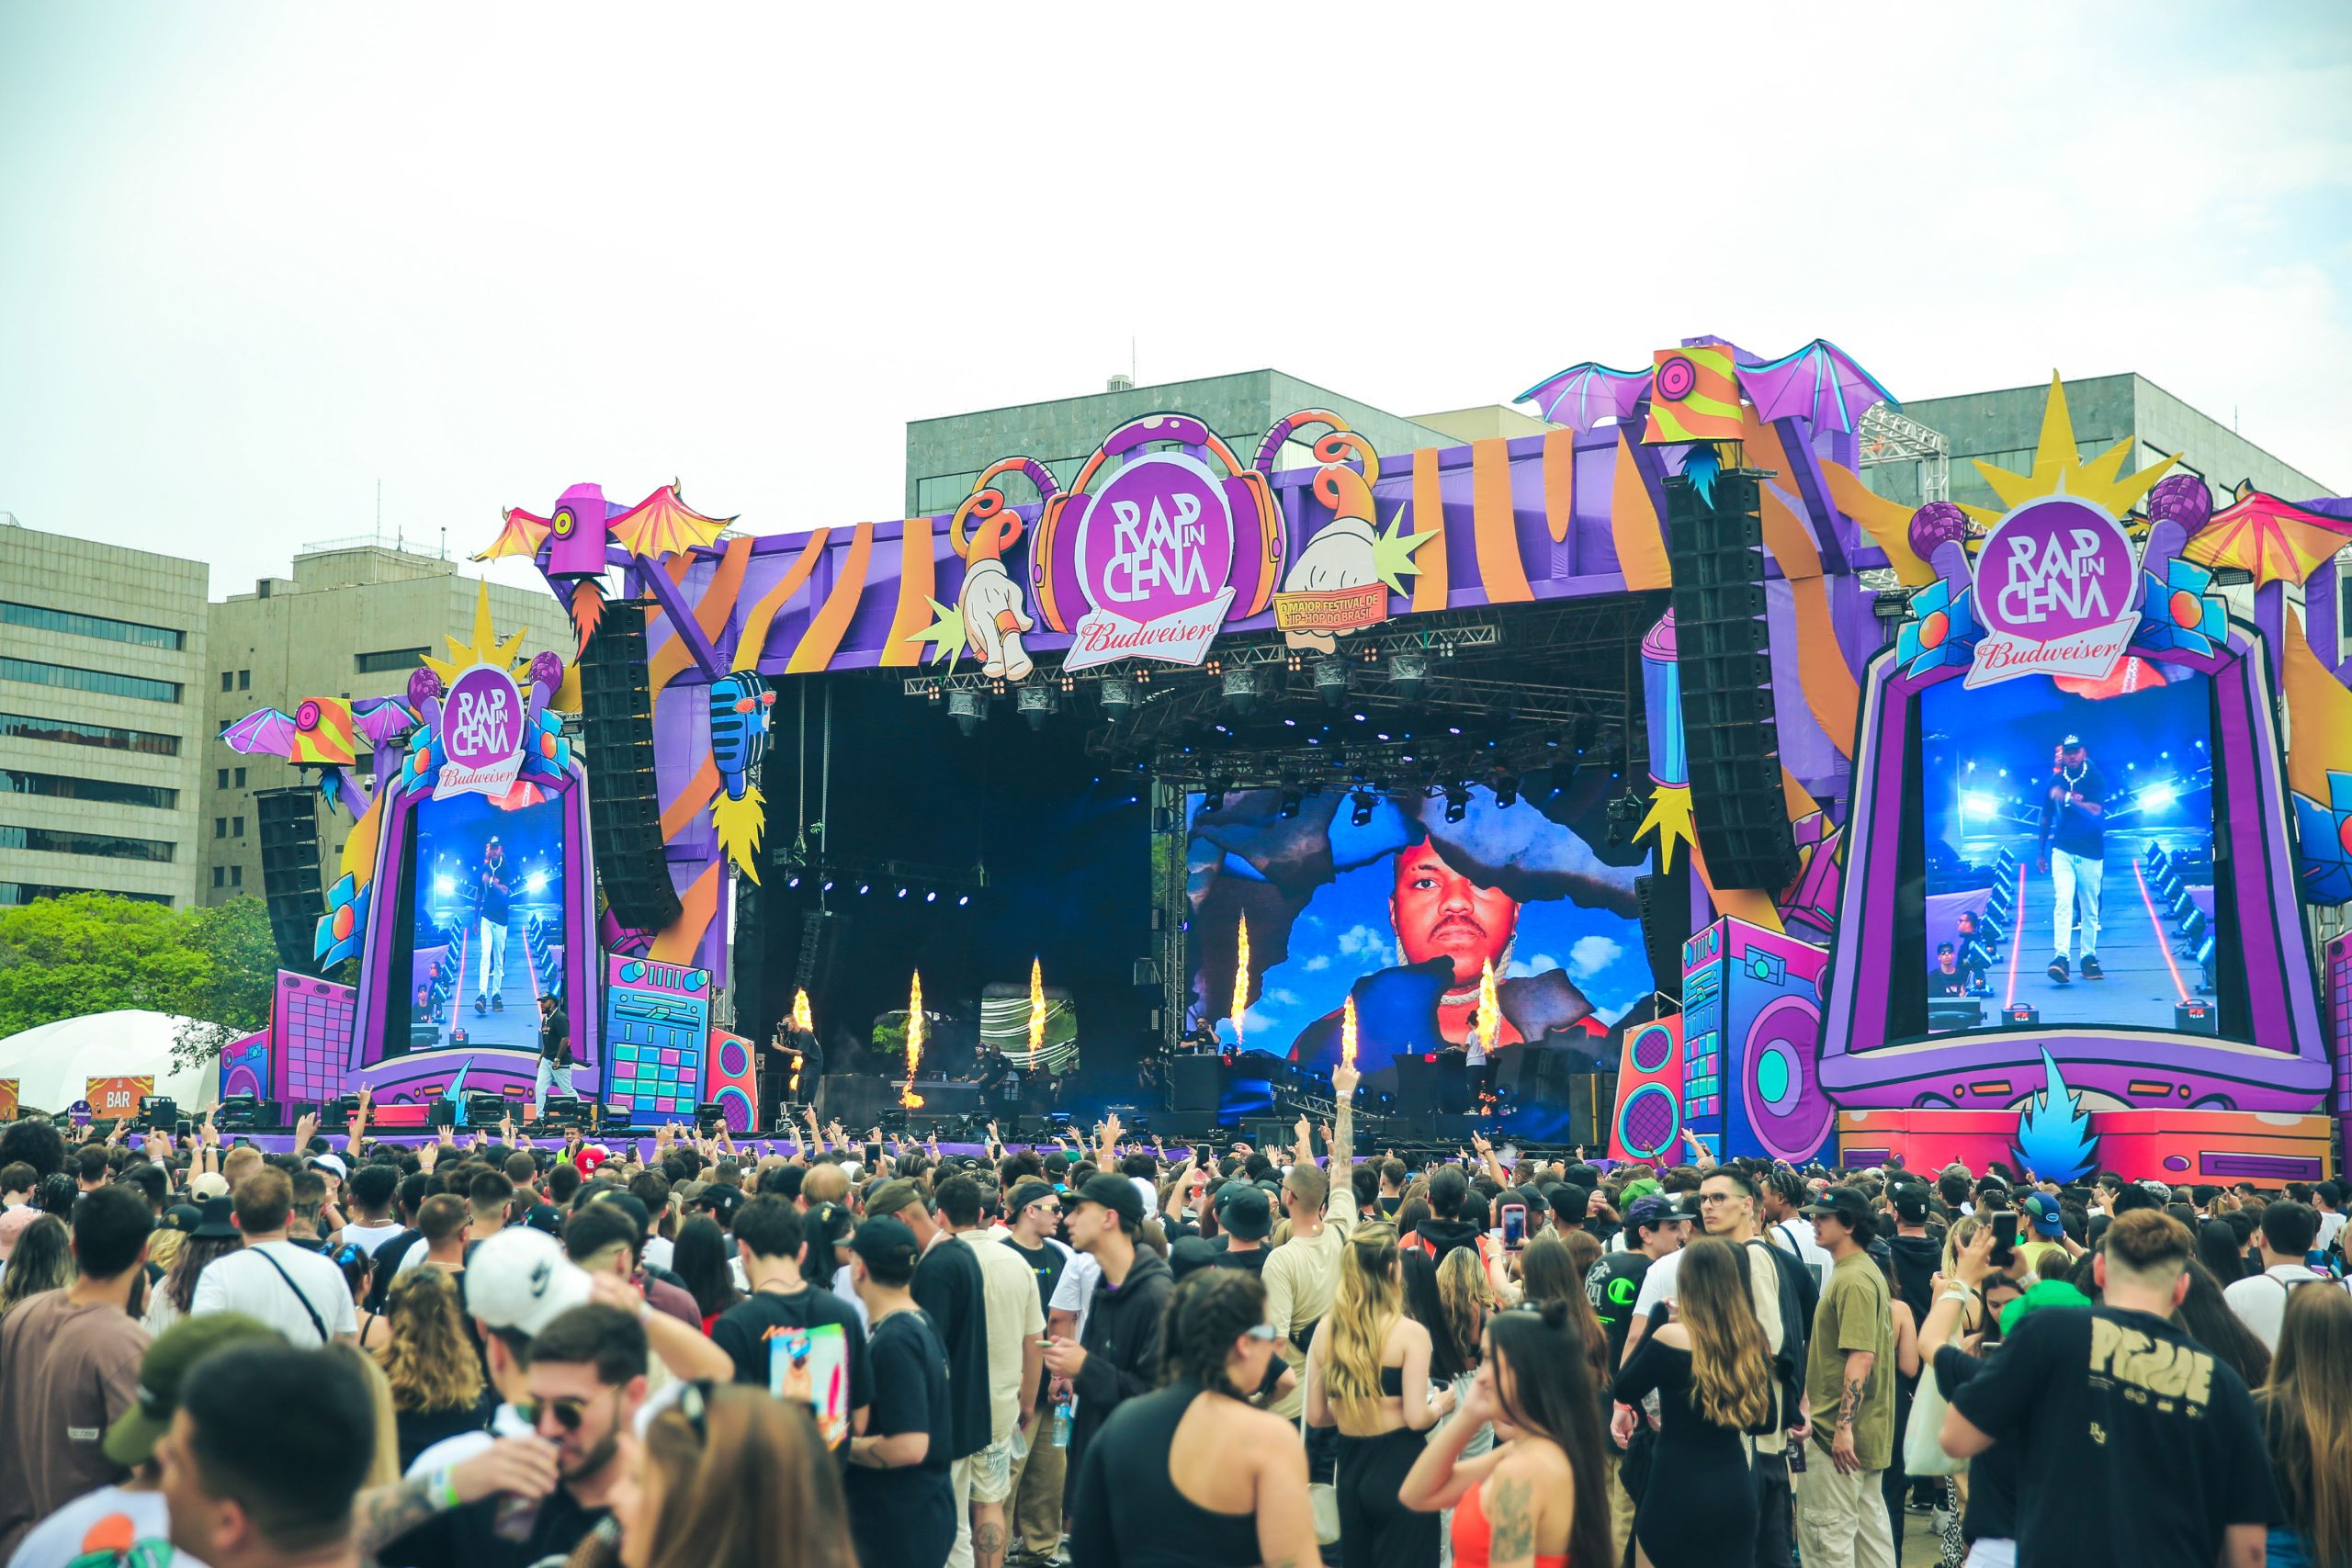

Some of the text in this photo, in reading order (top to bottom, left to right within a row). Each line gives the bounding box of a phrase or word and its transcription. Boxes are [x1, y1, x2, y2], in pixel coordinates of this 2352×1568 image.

[1111, 493, 1202, 557] RAP
[1182, 524, 1205, 547] IN
[2007, 529, 2100, 586] RAP
[2080, 557, 2105, 578] IN
[1103, 546, 1211, 603] CENA
[1281, 593, 1378, 614] O MAIOR FESTIVAL DE
[1997, 575, 2110, 625] CENA
[1285, 607, 1374, 626] HIP-HOP DO BRASIL
[1081, 620, 1216, 653] Budweiser
[1976, 639, 2121, 670] Budweiser
[458, 689, 506, 728] RAP
[495, 709, 508, 724] IN
[452, 722, 510, 757] CENA
[440, 768, 515, 788] Budweiser
[107, 1090, 130, 1109] BAR
